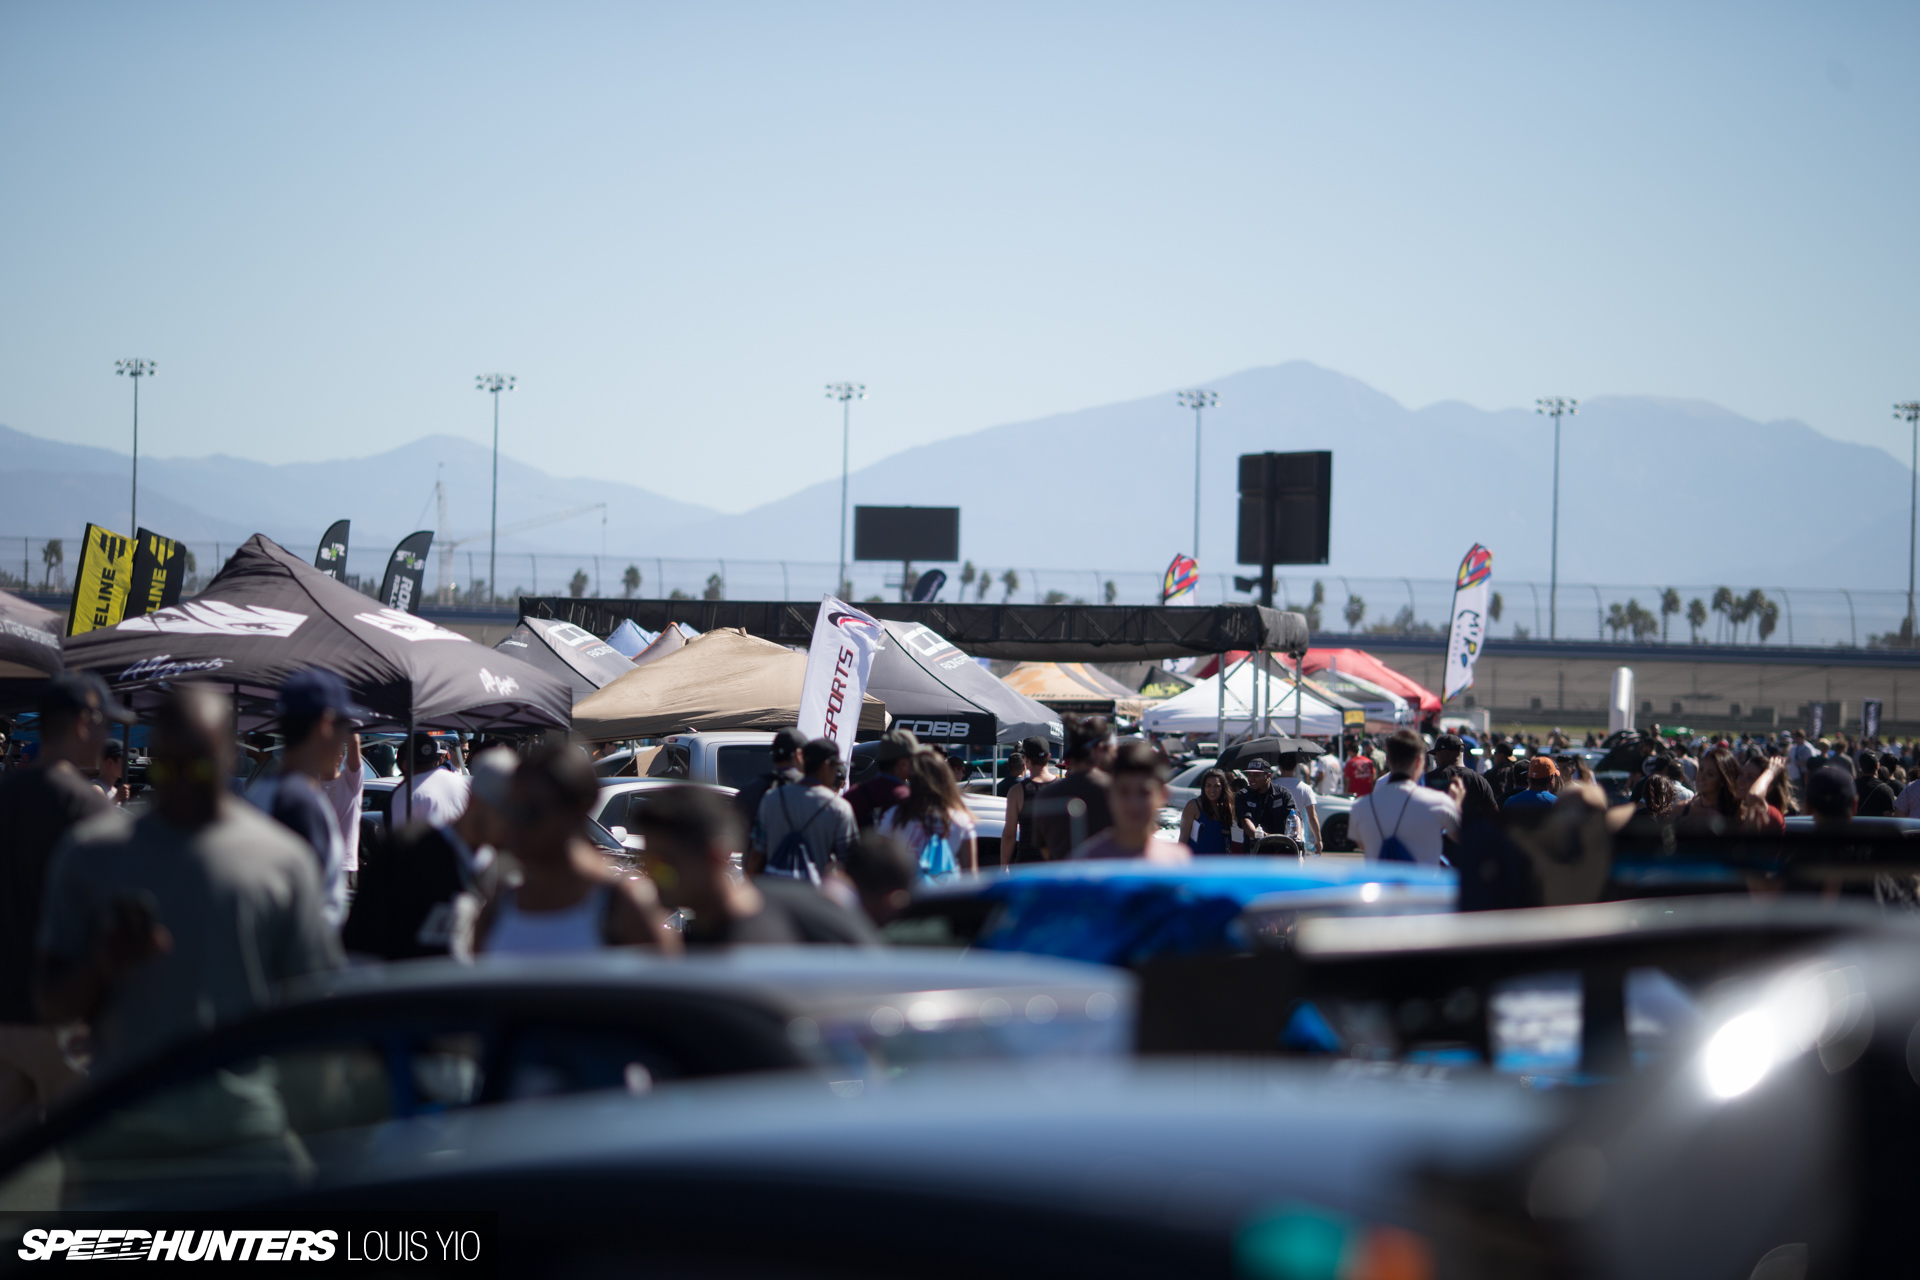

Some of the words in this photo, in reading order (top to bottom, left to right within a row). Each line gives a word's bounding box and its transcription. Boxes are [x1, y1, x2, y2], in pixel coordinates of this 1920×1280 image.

[93, 567, 117, 631] ELINE
[145, 567, 168, 616] LINE
[823, 644, 854, 742] SPORTS
[895, 719, 970, 737] COBB
